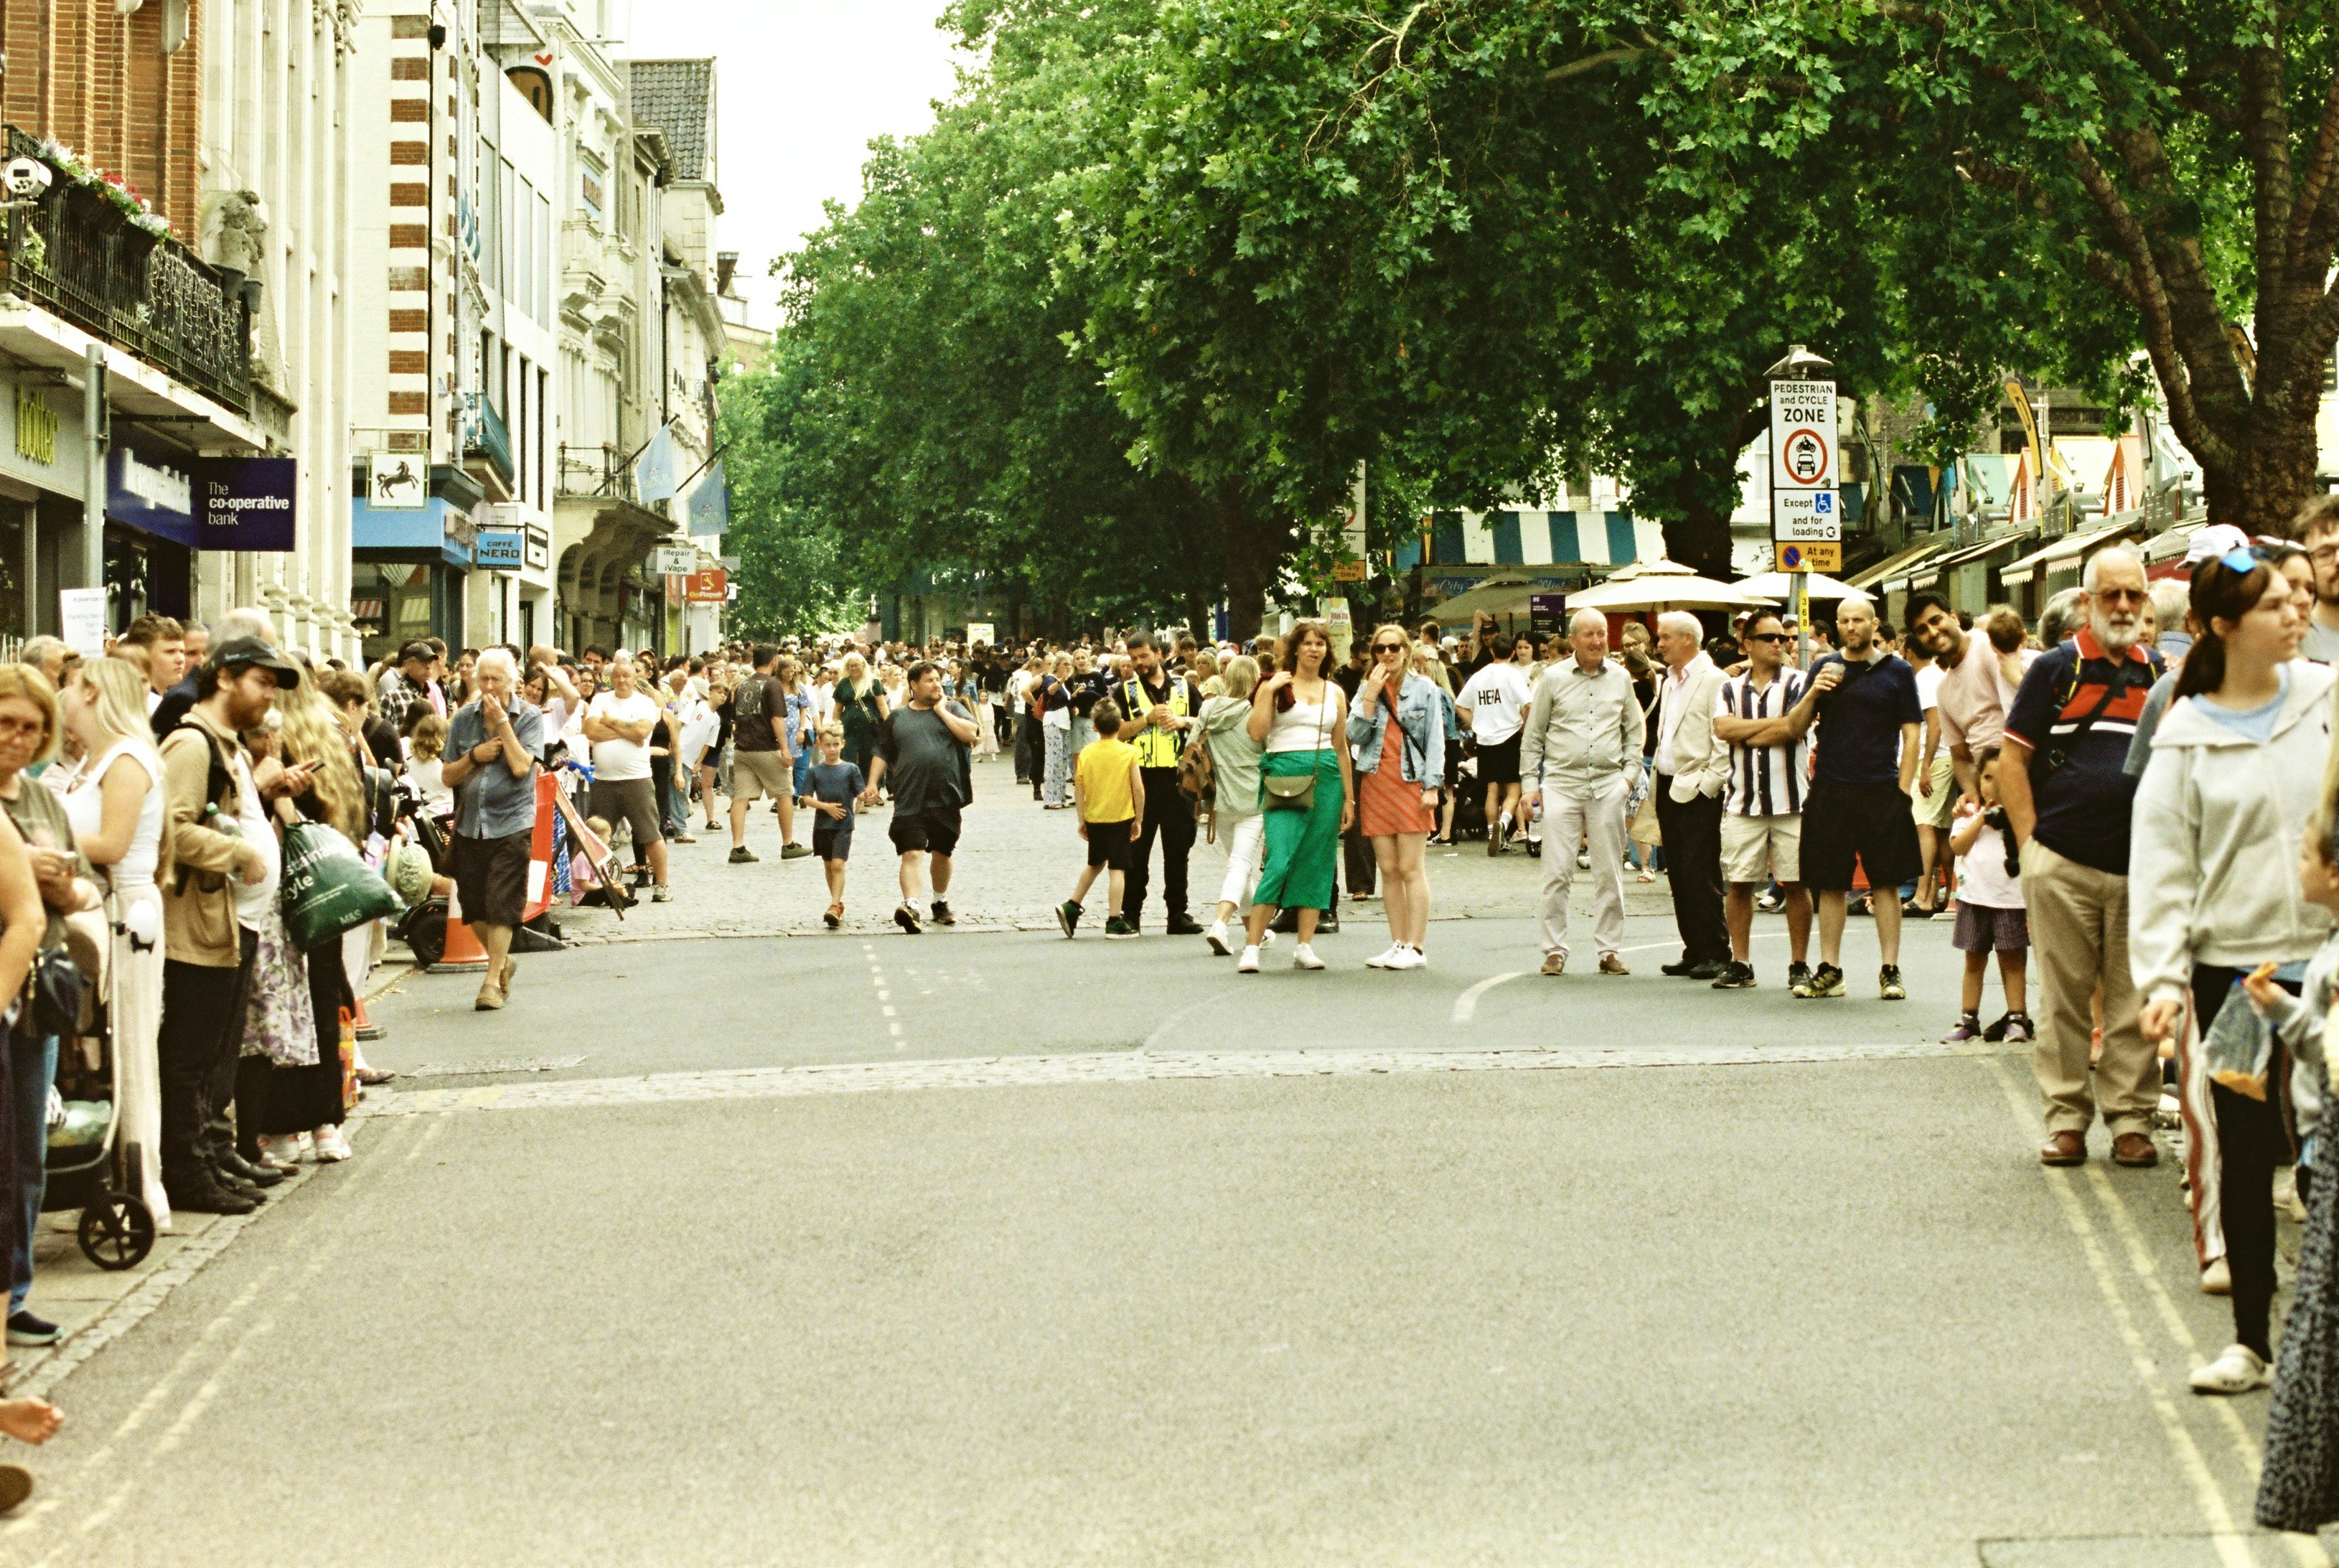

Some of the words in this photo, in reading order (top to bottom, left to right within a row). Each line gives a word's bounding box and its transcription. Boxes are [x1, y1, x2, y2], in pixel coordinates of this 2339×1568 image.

[1774, 384, 1833, 393] PEDESTRIAN
[1798, 396, 1828, 405] CYCLE
[1783, 408, 1825, 422] ZONE
[207, 482, 228, 495] The
[209, 496, 289, 512] co-operative
[1783, 498, 1813, 508] Except
[208, 512, 238, 525] bank
[1810, 516, 1822, 525] for
[1792, 527, 1824, 537] loading
[479, 549, 520, 558] NERO
[1806, 547, 1818, 555] At
[1820, 548, 1834, 556] any
[1811, 558, 1830, 567] time
[665, 564, 688, 573] iVape
[689, 591, 723, 599] GoRepair
